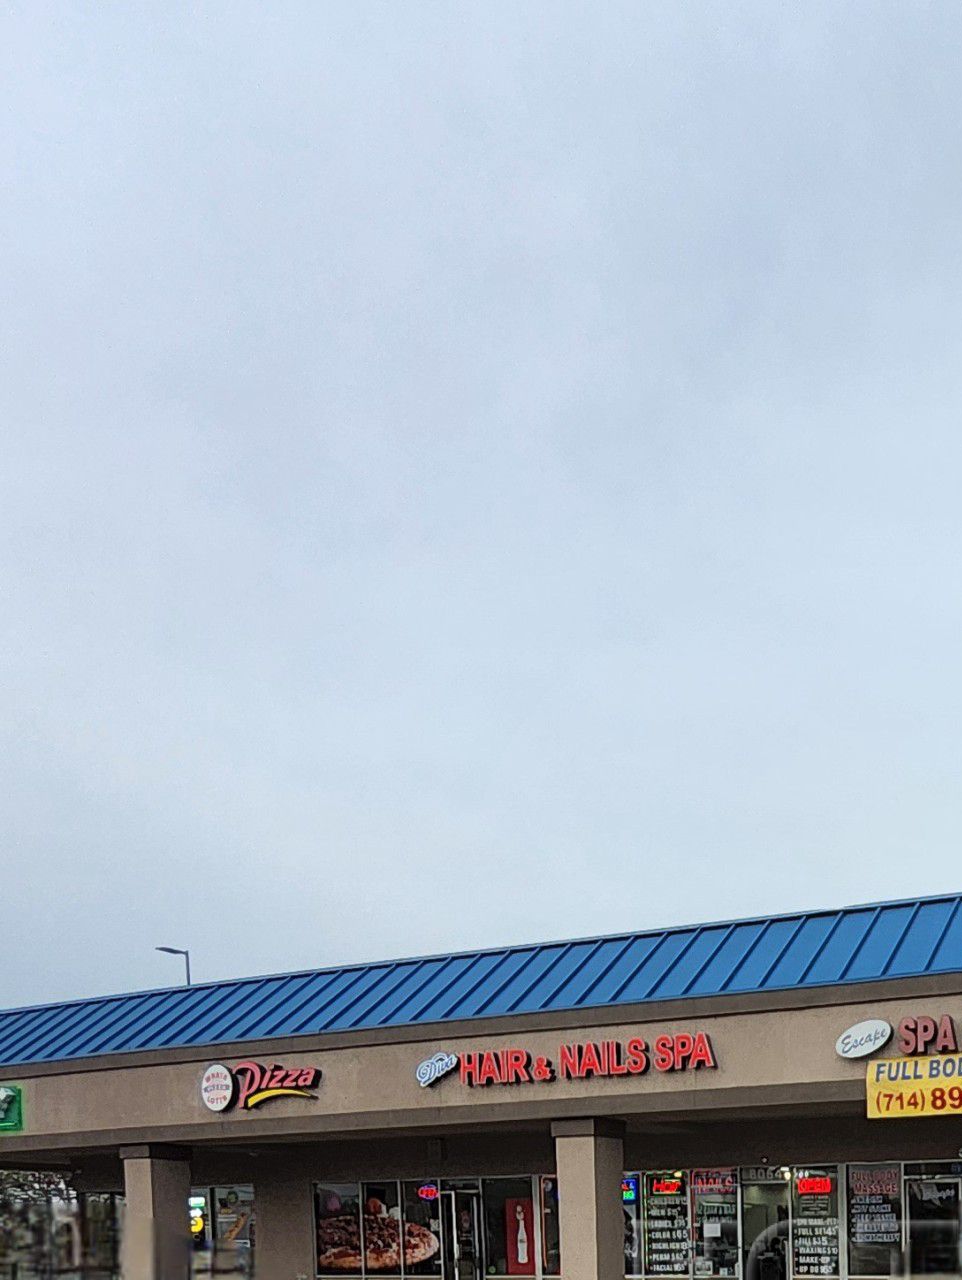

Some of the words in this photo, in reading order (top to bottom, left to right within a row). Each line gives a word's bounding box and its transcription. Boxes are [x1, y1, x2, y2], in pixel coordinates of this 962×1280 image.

[840, 1026, 888, 1055] Escape
[900, 1014, 958, 1055] SPA
[415, 1052, 458, 1087] Diva
[459, 1048, 530, 1086] HAIR
[533, 1055, 551, 1079] &
[560, 1037, 647, 1078] NAILS
[654, 1032, 715, 1071] SPA
[875, 1061, 924, 1083] FULL
[232, 1060, 316, 1109] Pizza
[876, 1088, 926, 1113] (714)
[798, 1178, 831, 1193] OPEN
[853, 1182, 898, 1194] MASSAGE
